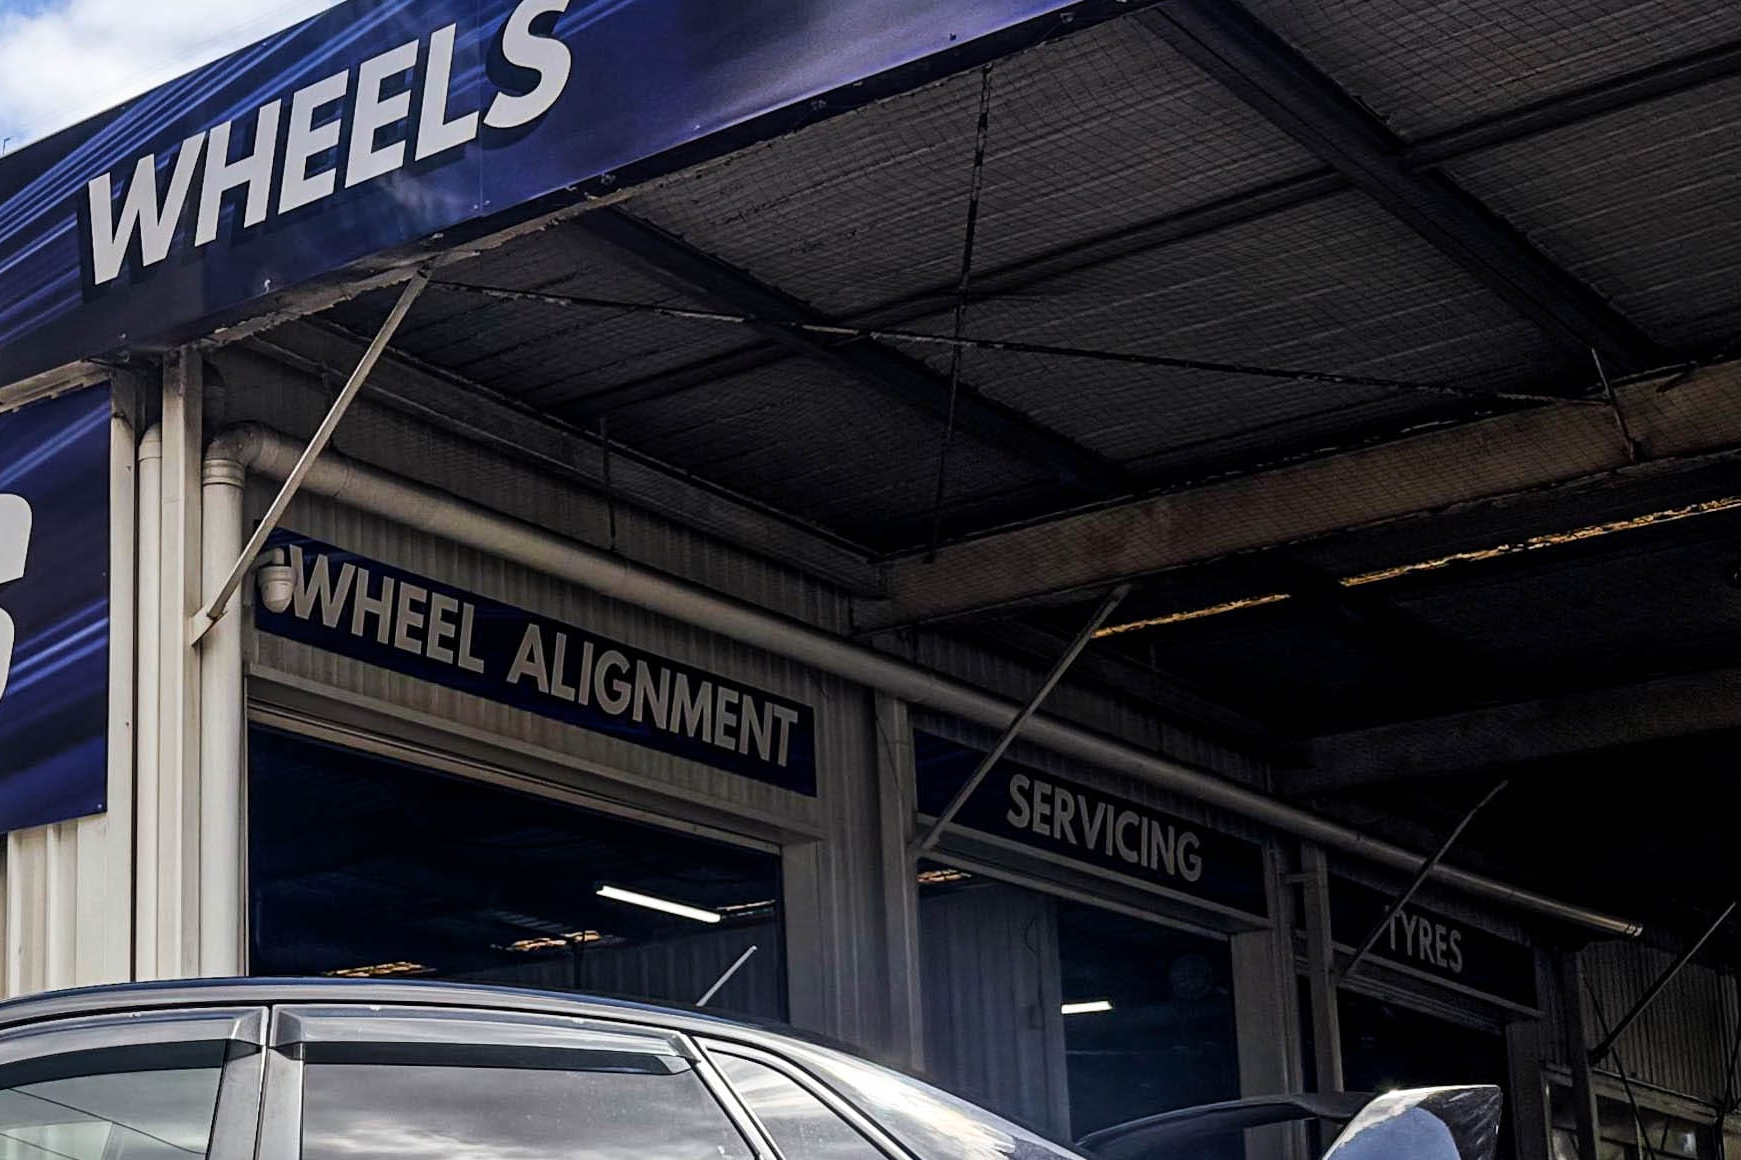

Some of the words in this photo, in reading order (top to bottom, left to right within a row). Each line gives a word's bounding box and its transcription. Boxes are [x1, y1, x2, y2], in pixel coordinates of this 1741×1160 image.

[88, 0, 572, 286] WHEELS
[288, 543, 484, 673] WHEEL
[507, 624, 798, 767] ALIGNMENT
[1006, 774, 1202, 882] SERVICING
[1381, 904, 1464, 973] TYRES
